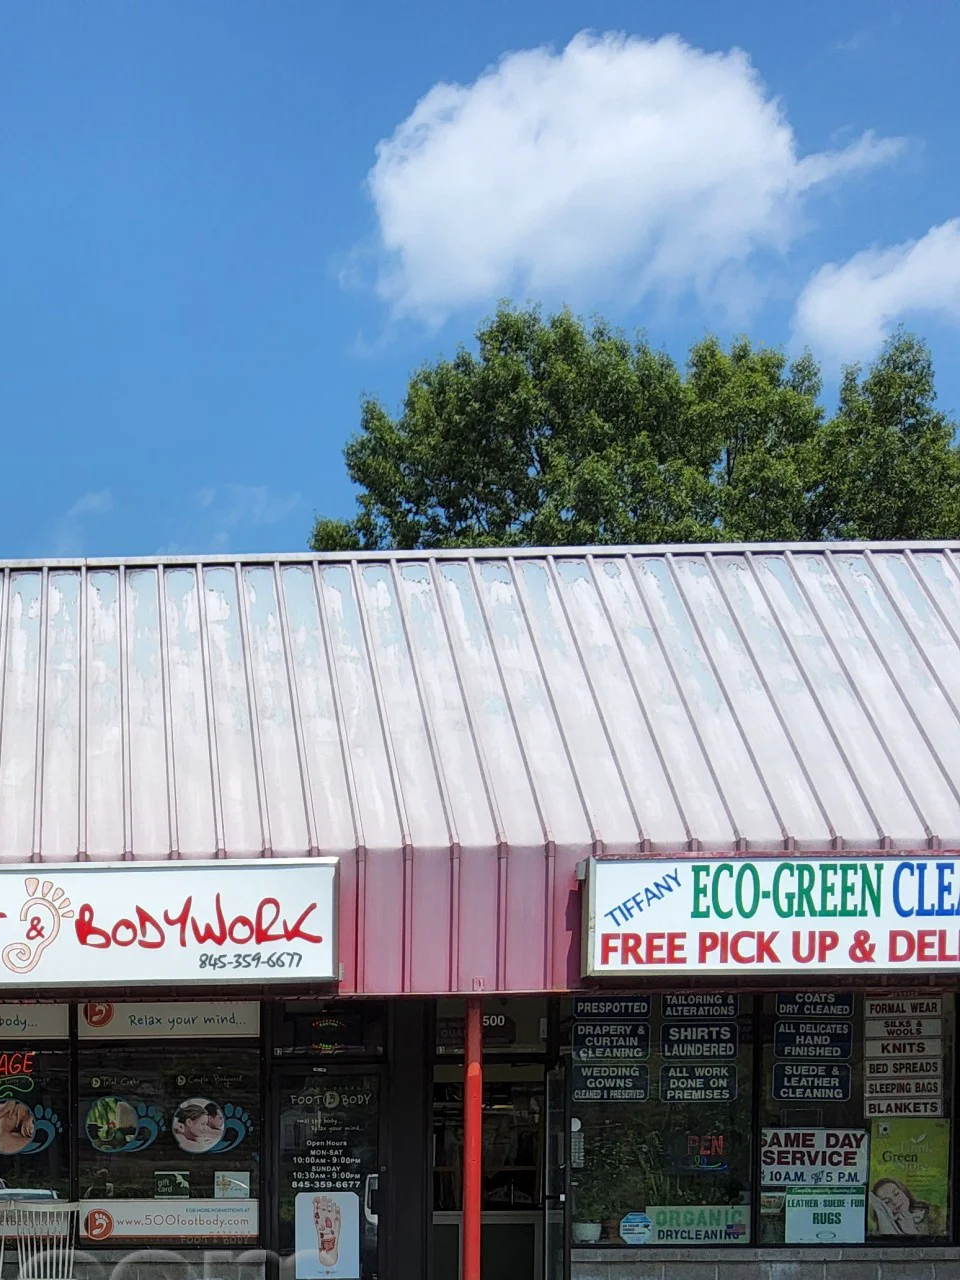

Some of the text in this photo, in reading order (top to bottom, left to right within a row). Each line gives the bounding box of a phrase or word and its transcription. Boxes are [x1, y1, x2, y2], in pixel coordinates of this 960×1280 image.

[690, 862, 884, 919] ECO-GREEN
[604, 868, 683, 927] TIFFANY
[25, 916, 46, 941] &
[75, 893, 323, 948] BODYWORK
[600, 929, 960, 965] FREE PICK UP & DEL
[199, 952, 303, 970] 845-359-6677
[665, 995, 734, 1004] TAILORING &
[795, 993, 835, 1003] COATS
[577, 1002, 648, 1013] PRESPOTTED
[665, 1006, 735, 1015] ALTERATIONS
[779, 1004, 850, 1014] DRY CLEANED
[870, 1002, 937, 1014] FORMAL WEAR
[129, 1014, 162, 1027] Relax
[168, 1015, 199, 1031] your
[482, 1015, 505, 1026] 500
[883, 1020, 911, 1028] SILKS
[577, 1025, 645, 1035] DRAPERY &
[668, 1027, 731, 1040] SHIRTS
[779, 1024, 849, 1034] ALL DELICATES
[886, 1028, 922, 1036] WOOLS
[585, 1036, 638, 1046] CURTAIN
[795, 1036, 830, 1045] HAND
[580, 1048, 643, 1057] CLEANING
[664, 1043, 734, 1056] LAUNDERED
[784, 1047, 841, 1056] FINISHED
[881, 1042, 926, 1054] KNITS
[581, 1067, 640, 1077] WEDDING
[668, 1067, 729, 1077] ALL WORK
[784, 1066, 840, 1076] SUEDE &
[869, 1062, 938, 1074] BED SPREADS
[586, 1078, 633, 1088] GOWNS
[670, 1078, 727, 1088] DONE ON
[784, 1077, 839, 1087] LEATHER
[780, 1088, 843, 1098] CLEANING
[869, 1082, 938, 1094] SLEEPING BAGS
[290, 1094, 372, 1105] FOOT BODY
[574, 1090, 601, 1099] CLEANED
[610, 1090, 645, 1099] PRESERVED
[667, 1090, 730, 1100] PREMISES
[868, 1102, 938, 1114] BLANKETS
[760, 1133, 866, 1148] SAME DAY
[762, 1150, 858, 1166] SERVICE
[882, 1150, 918, 1163] Green
[825, 1172, 833, 1182] 5
[157, 1178, 170, 1188] gift
[157, 1185, 173, 1193] card
[787, 1199, 819, 1207] LEATHER
[823, 1199, 845, 1207] SUEDE
[850, 1199, 864, 1207] FUR
[116, 1214, 249, 1228] www.500footbody.com
[656, 1210, 743, 1226] ORGANIC
[812, 1212, 842, 1225] RUGS
